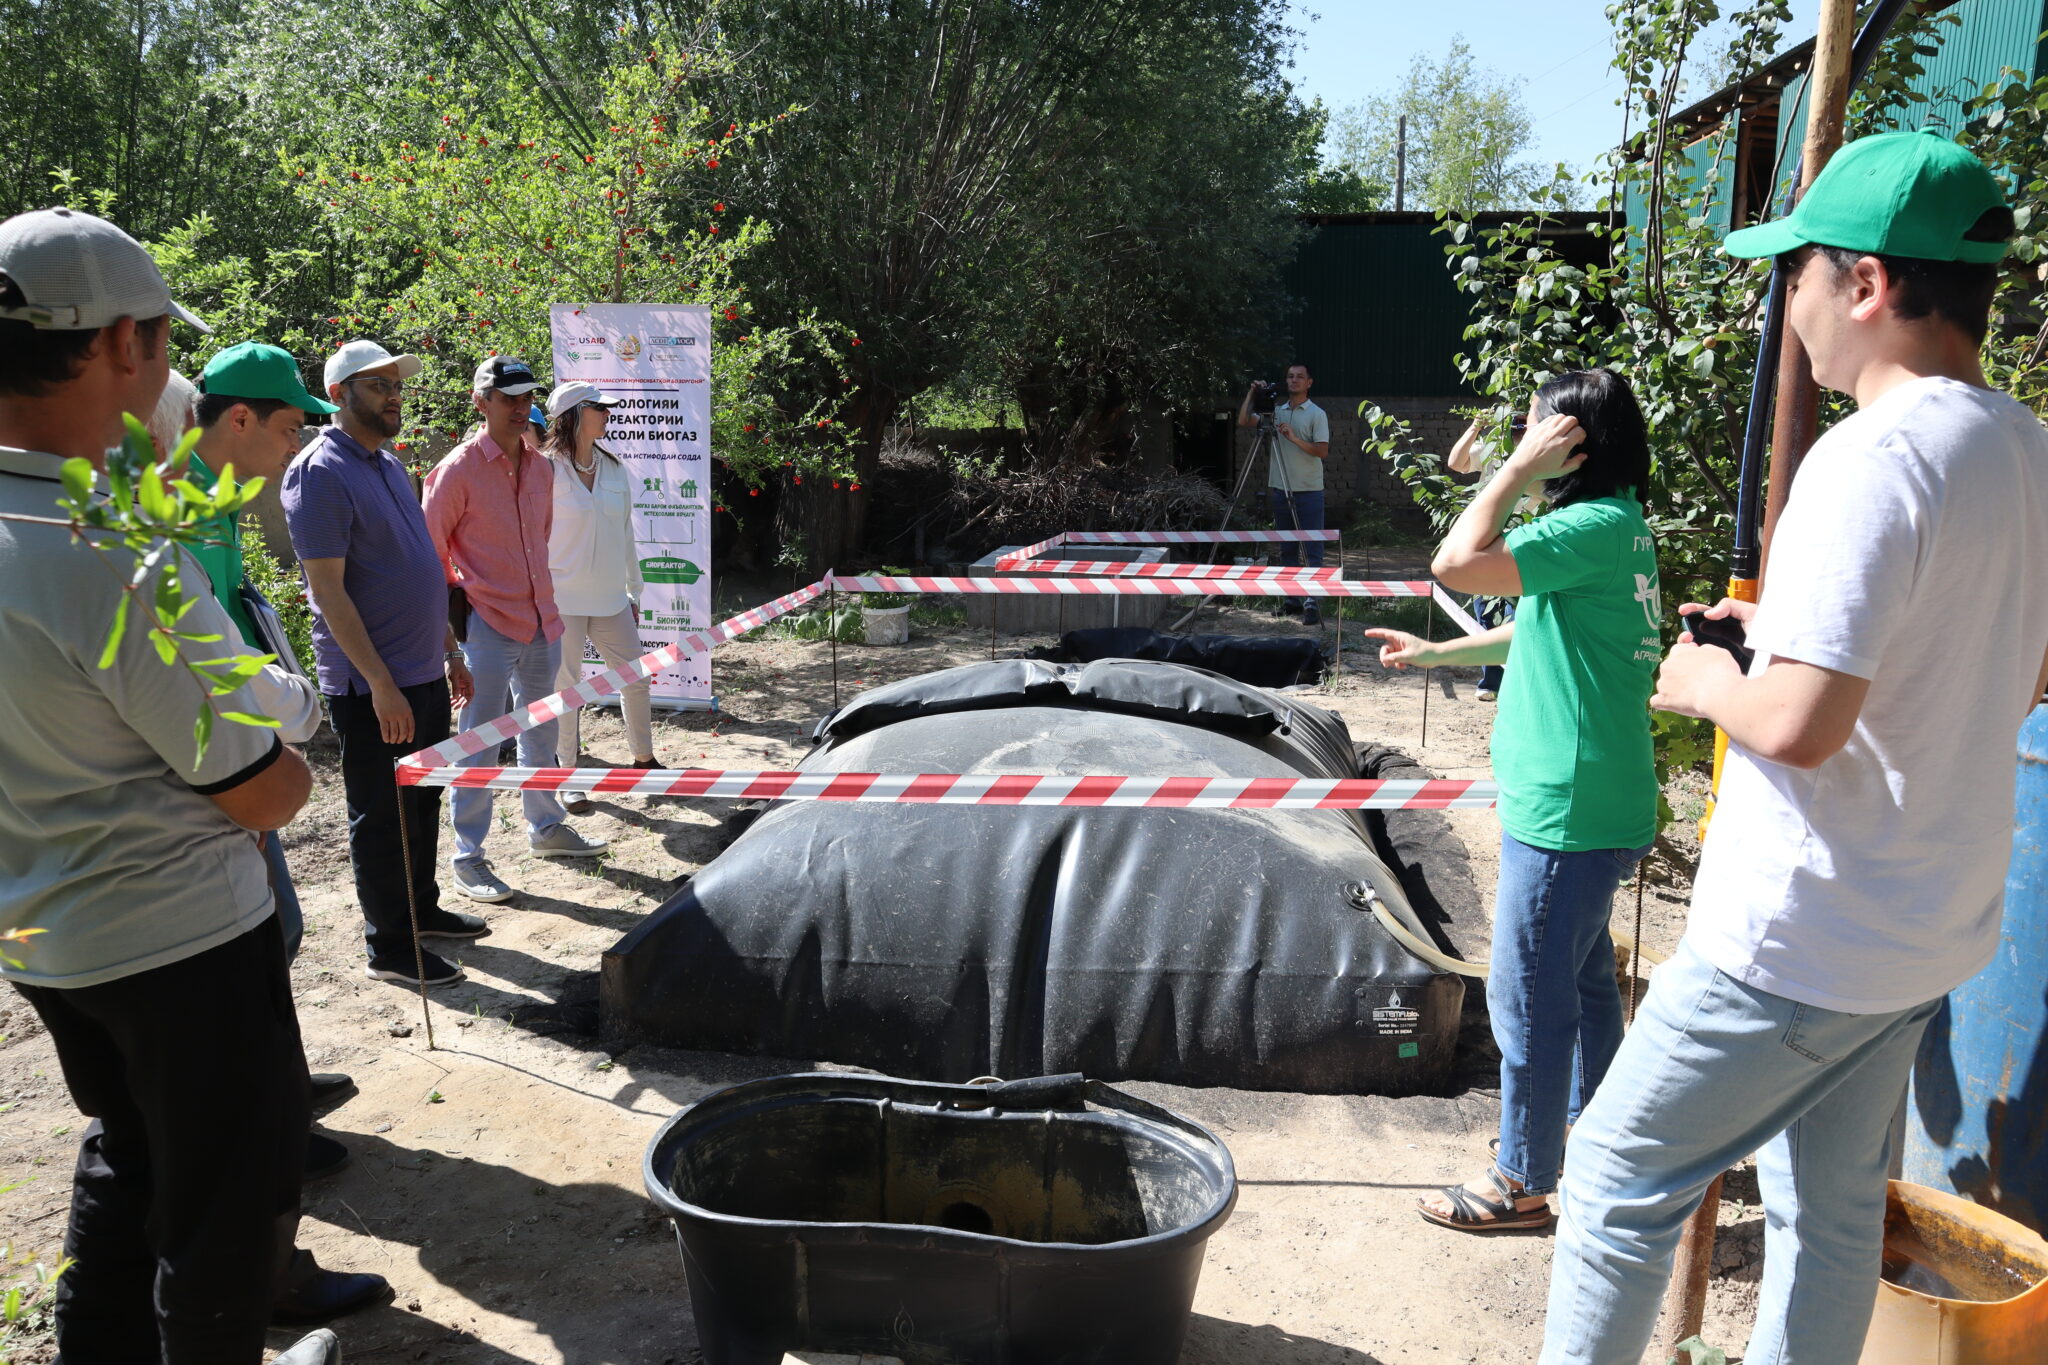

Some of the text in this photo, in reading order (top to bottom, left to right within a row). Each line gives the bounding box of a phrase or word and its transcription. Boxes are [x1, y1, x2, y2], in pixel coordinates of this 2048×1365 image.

[578, 337, 606, 345] USAID
[618, 399, 679, 409] ОЛОГИЯИ
[602, 430, 697, 442] ҲСОЛИ БИОГАЗ
[1633, 535, 1655, 552] ГУР
[645, 561, 686, 569] БИОРЕАКТОР
